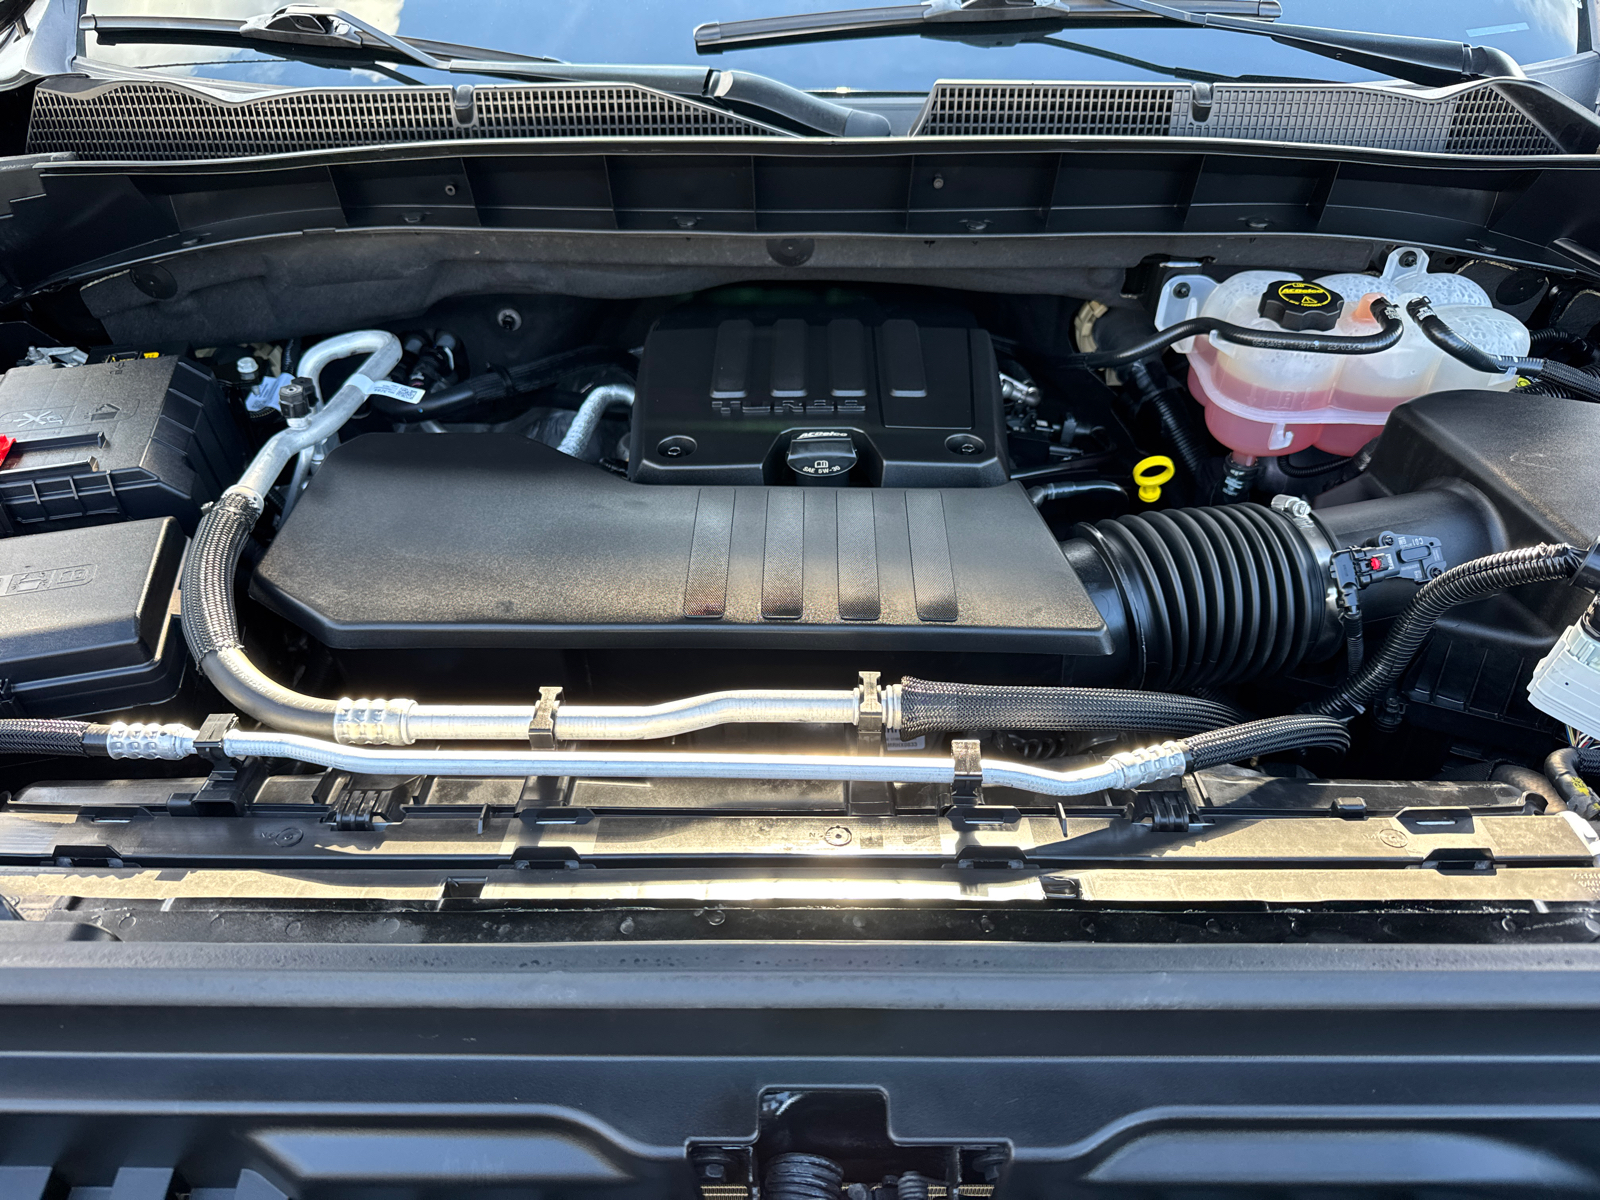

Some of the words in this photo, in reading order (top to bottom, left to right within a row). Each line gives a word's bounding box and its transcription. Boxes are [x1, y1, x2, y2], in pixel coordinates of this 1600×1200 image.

[797, 431, 848, 439] ACDelco
[803, 466, 816, 474] SAE
[818, 465, 841, 474] 5W-30
